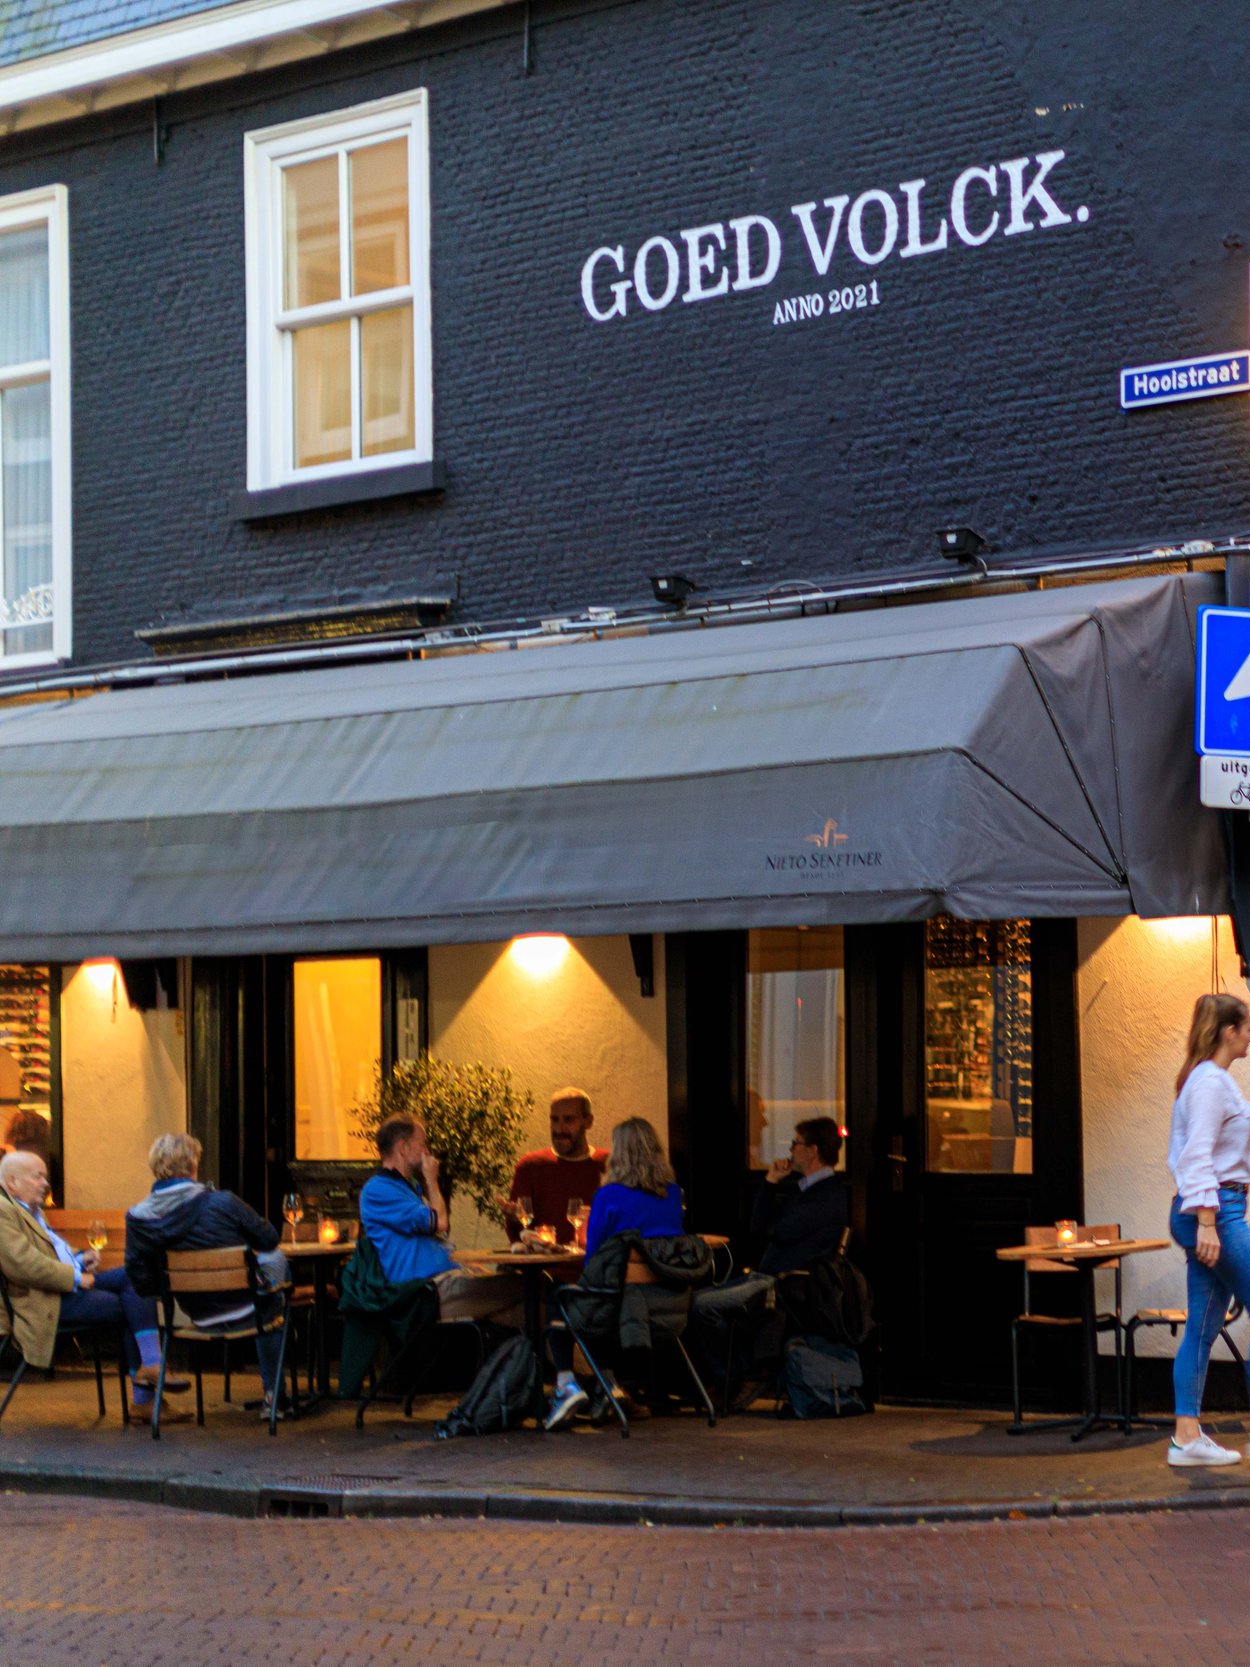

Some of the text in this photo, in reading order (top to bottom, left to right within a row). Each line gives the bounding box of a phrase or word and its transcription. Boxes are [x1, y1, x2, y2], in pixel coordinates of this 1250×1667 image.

[580, 149, 1090, 321] GOED VOLCK.
[772, 280, 881, 325] ANNO 2021
[766, 851, 882, 870] NIETO SENETINER
